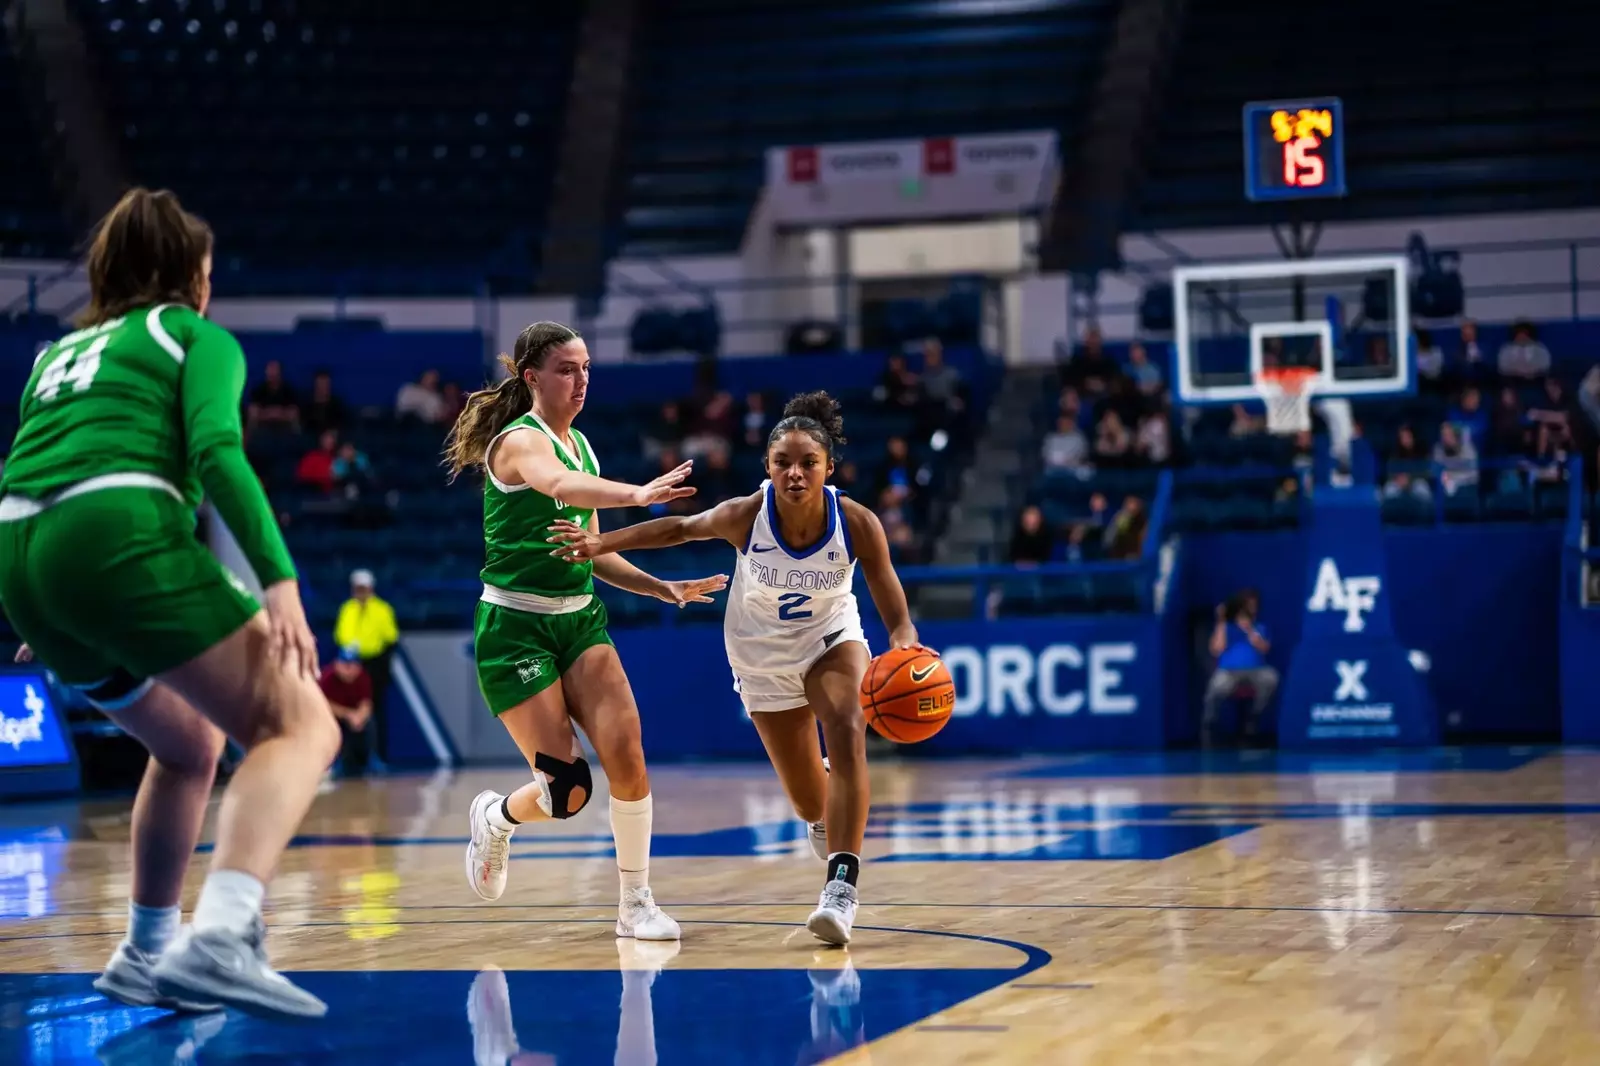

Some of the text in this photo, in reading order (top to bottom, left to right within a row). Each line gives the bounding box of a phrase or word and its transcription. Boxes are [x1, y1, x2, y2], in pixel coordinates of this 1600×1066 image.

[1283, 136, 1325, 187] 15
[32, 334, 110, 403] 44
[749, 558, 846, 590] FALCONS
[1307, 557, 1381, 632] AF
[778, 593, 812, 620] 2
[918, 690, 954, 711] ELITE
[940, 643, 1138, 716] ORCE
